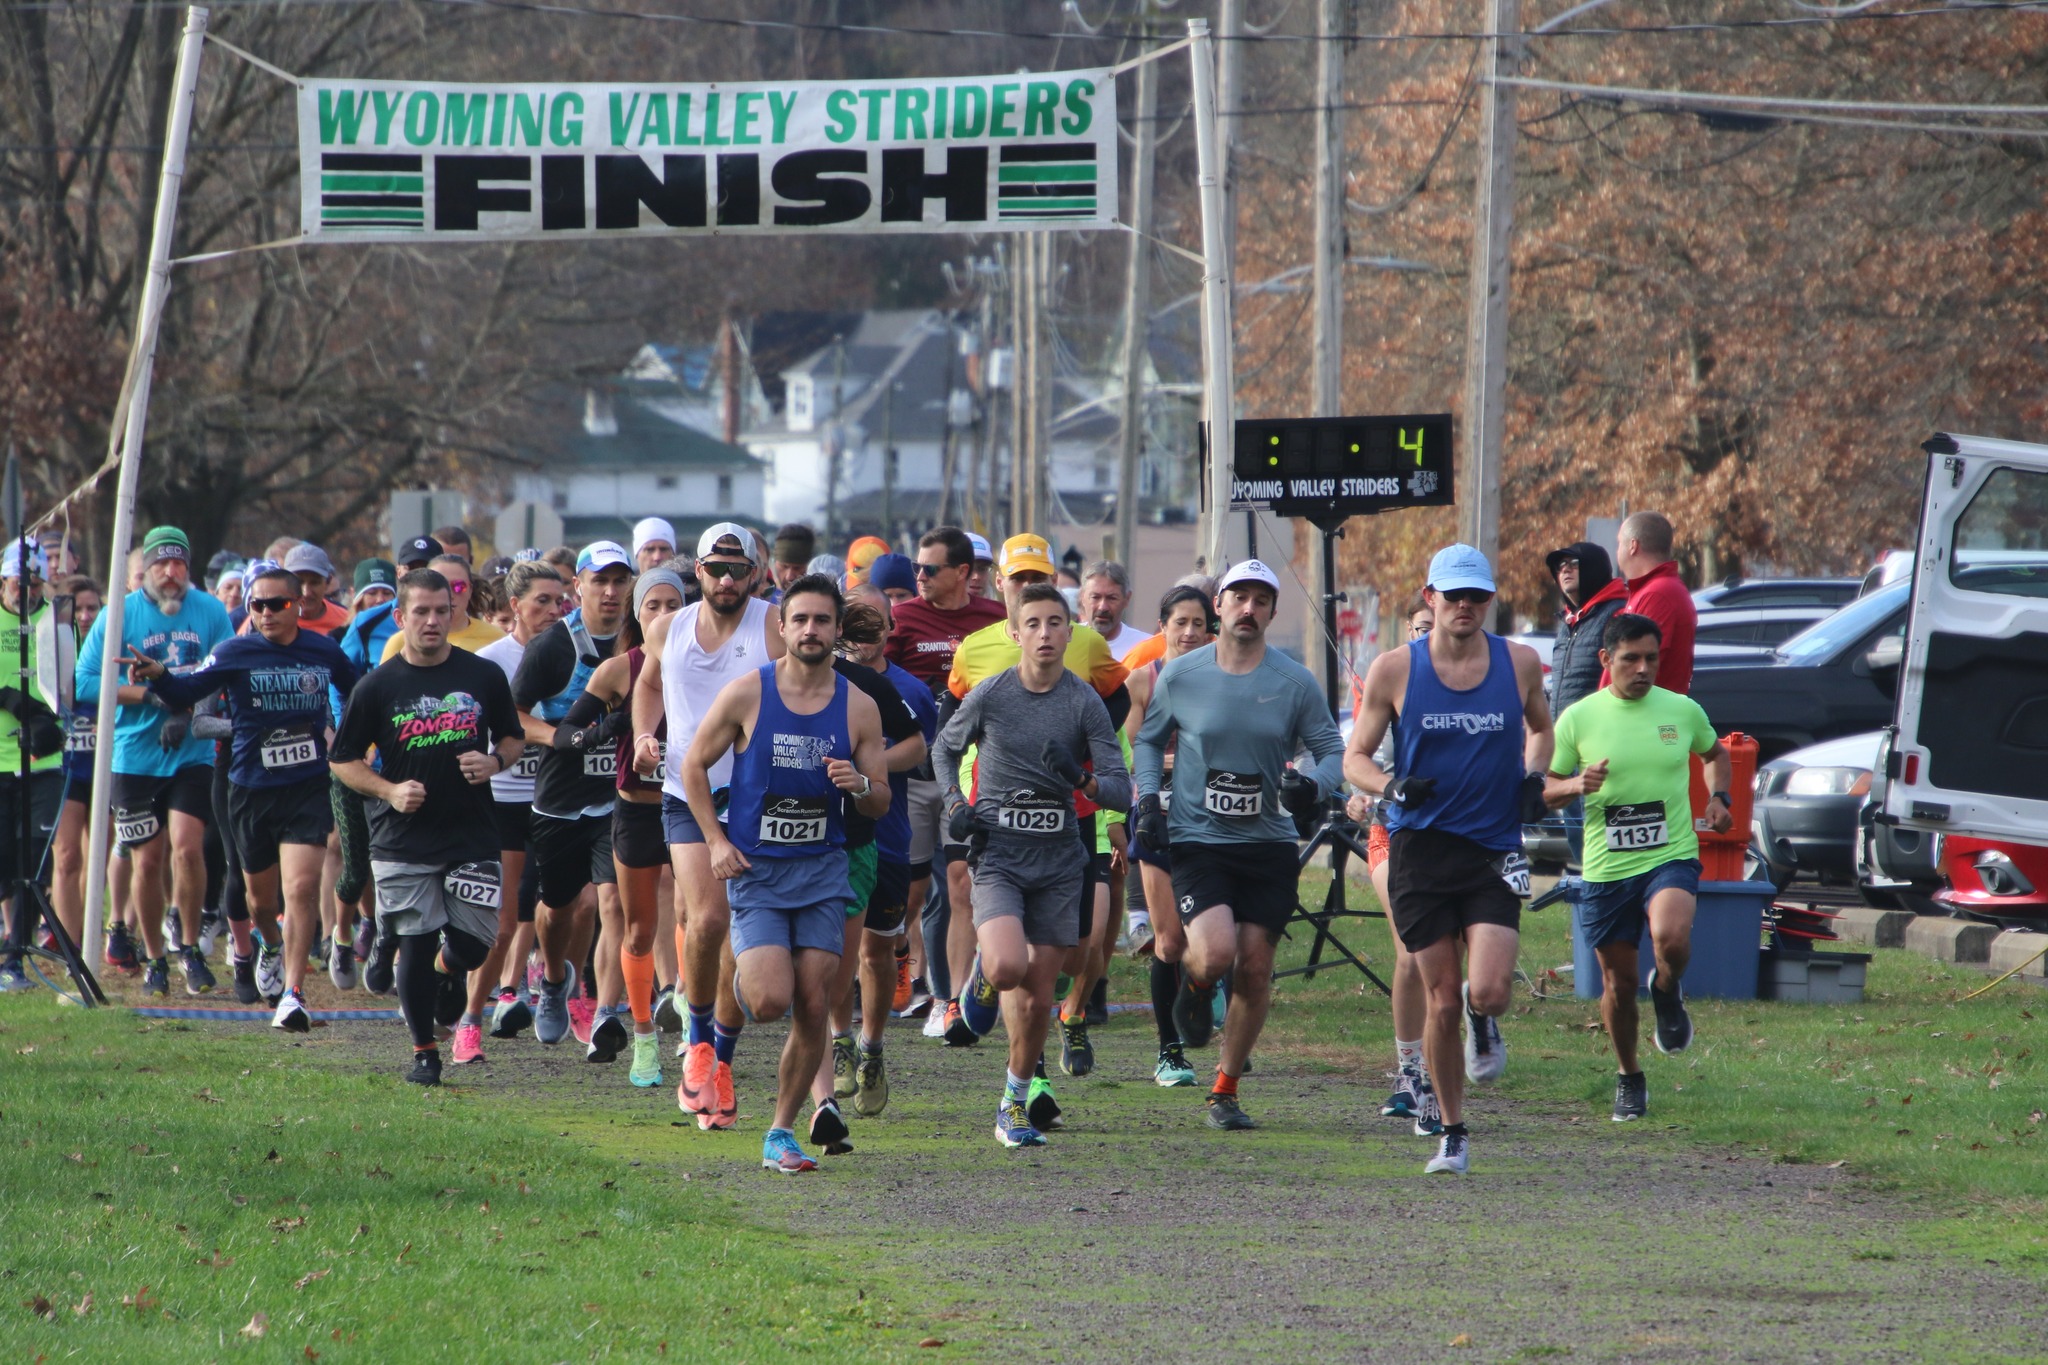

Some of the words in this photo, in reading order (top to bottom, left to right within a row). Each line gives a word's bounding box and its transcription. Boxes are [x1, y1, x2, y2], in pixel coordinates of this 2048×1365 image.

[318, 89, 584, 147] WYOMING
[608, 90, 798, 146] VALLEY
[824, 78, 1096, 144] STRIDERS
[434, 146, 989, 231] FINISH
[1290, 478, 1336, 498] VALLEY
[1341, 477, 1400, 497] STRIDERS
[143, 633, 165, 649] BEER
[171, 631, 201, 644] BAGEL
[917, 641, 951, 653] SCRANTON
[250, 673, 331, 693] STEAMTOW
[392, 712, 416, 728] THE
[399, 711, 477, 742] ZOMBIE
[406, 735, 437, 751] FUN
[435, 729, 470, 745] RUN
[773, 733, 804, 747] WYOMING
[267, 744, 311, 764] 1118
[773, 744, 797, 757] VALLEY
[772, 756, 803, 769] STRIDERS
[1209, 792, 1257, 813] 1041
[118, 820, 154, 839] 1007
[766, 820, 820, 840] 1021
[1004, 810, 1060, 830] 1029
[1612, 825, 1662, 846] 1137
[448, 880, 497, 903] 1027
